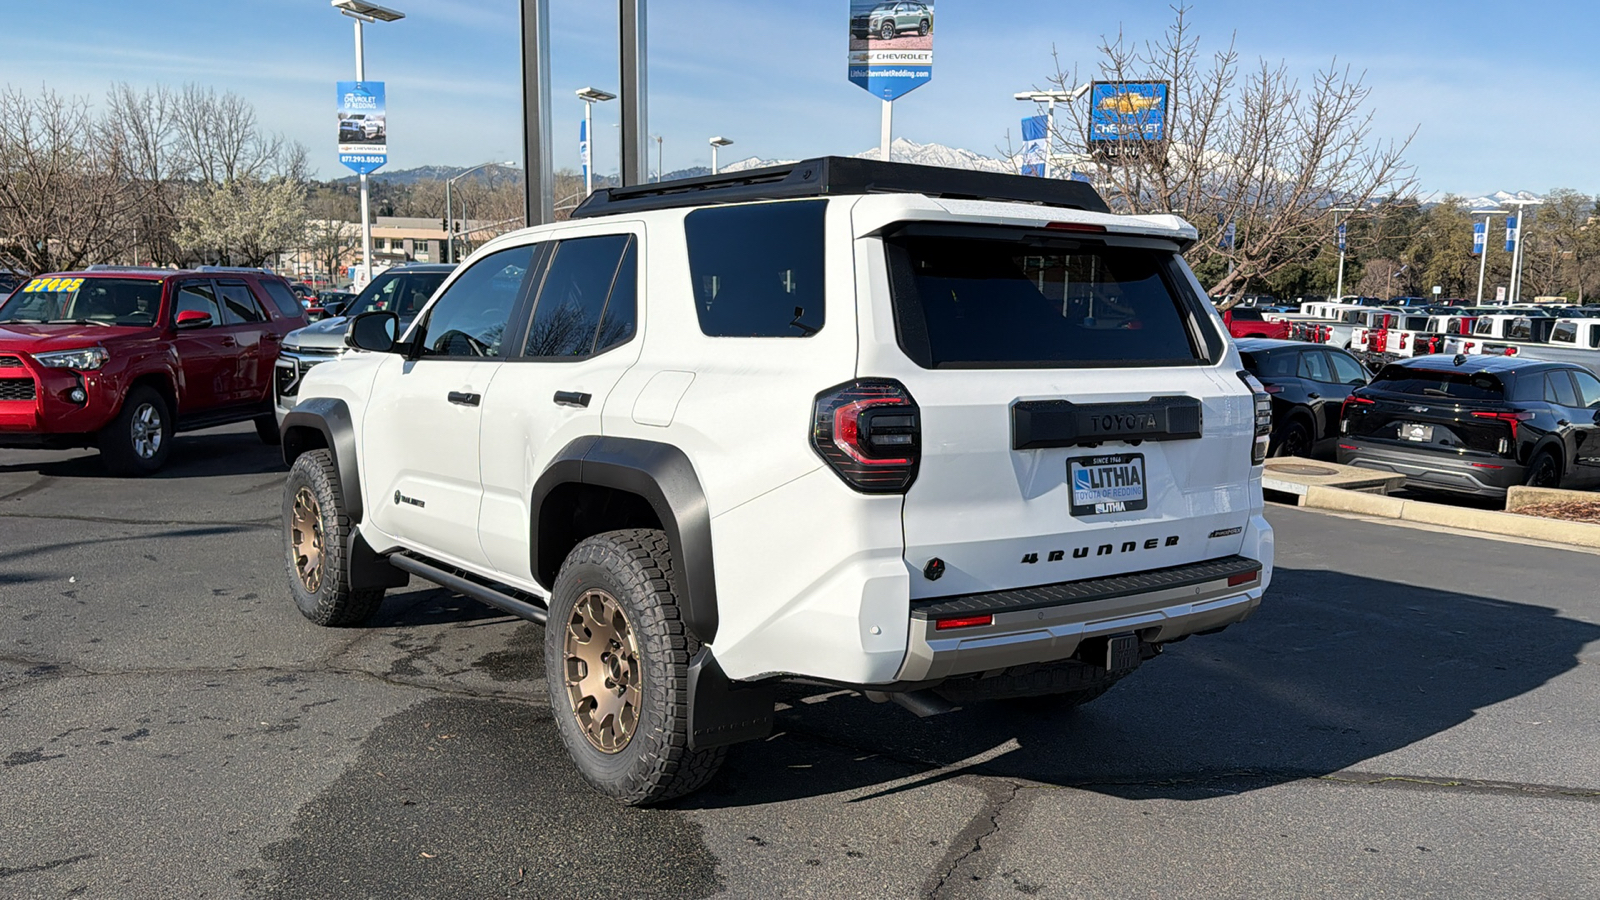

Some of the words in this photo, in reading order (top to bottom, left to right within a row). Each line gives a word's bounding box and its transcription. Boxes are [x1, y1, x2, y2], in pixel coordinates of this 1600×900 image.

[850, 69, 929, 79] LithiaChevroletRedding.com
[1094, 123, 1160, 133] CHEVLET
[1108, 146, 1142, 156] LIHI
[341, 155, 384, 163] 877.293.5503
[1091, 414, 1156, 431] TOYOTA
[1089, 466, 1141, 489] LITHIA
[1075, 490, 1101, 500] TOYOTA
[1102, 489, 1111, 498] OF
[1113, 487, 1142, 497] REDDING
[1103, 502, 1126, 513] LITHIA
[1021, 535, 1179, 564] 4RUNNER
